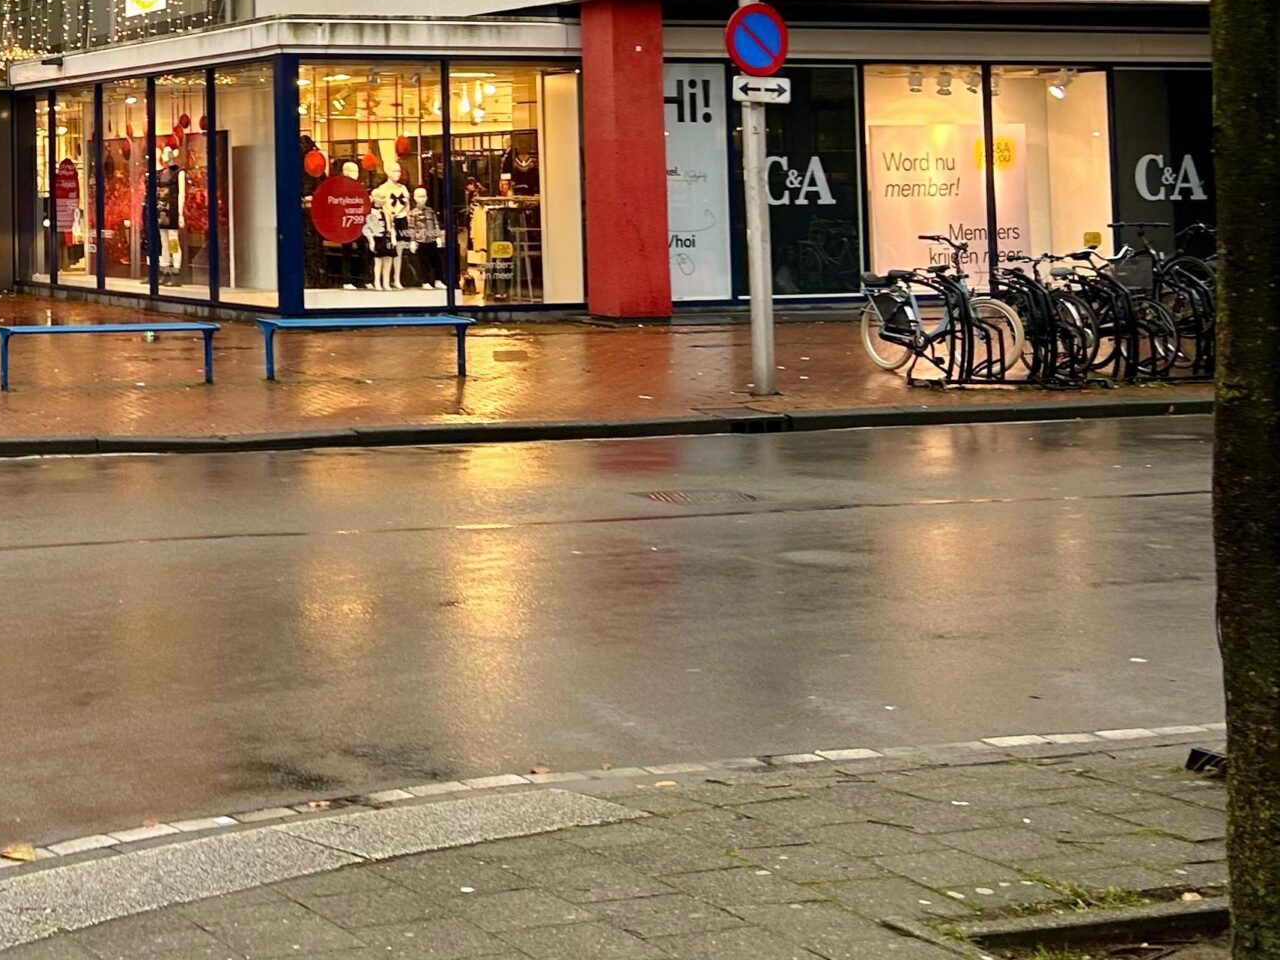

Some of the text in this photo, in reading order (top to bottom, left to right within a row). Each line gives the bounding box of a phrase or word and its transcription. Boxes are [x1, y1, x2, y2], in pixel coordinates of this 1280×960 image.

[883, 152, 955, 171] Word nu
[765, 155, 837, 206] C&A
[1135, 153, 1208, 201] C&A
[884, 177, 961, 198] member!
[327, 195, 365, 206] Partylooks
[344, 206, 365, 214] vanaf
[949, 223, 1021, 241] Memers
